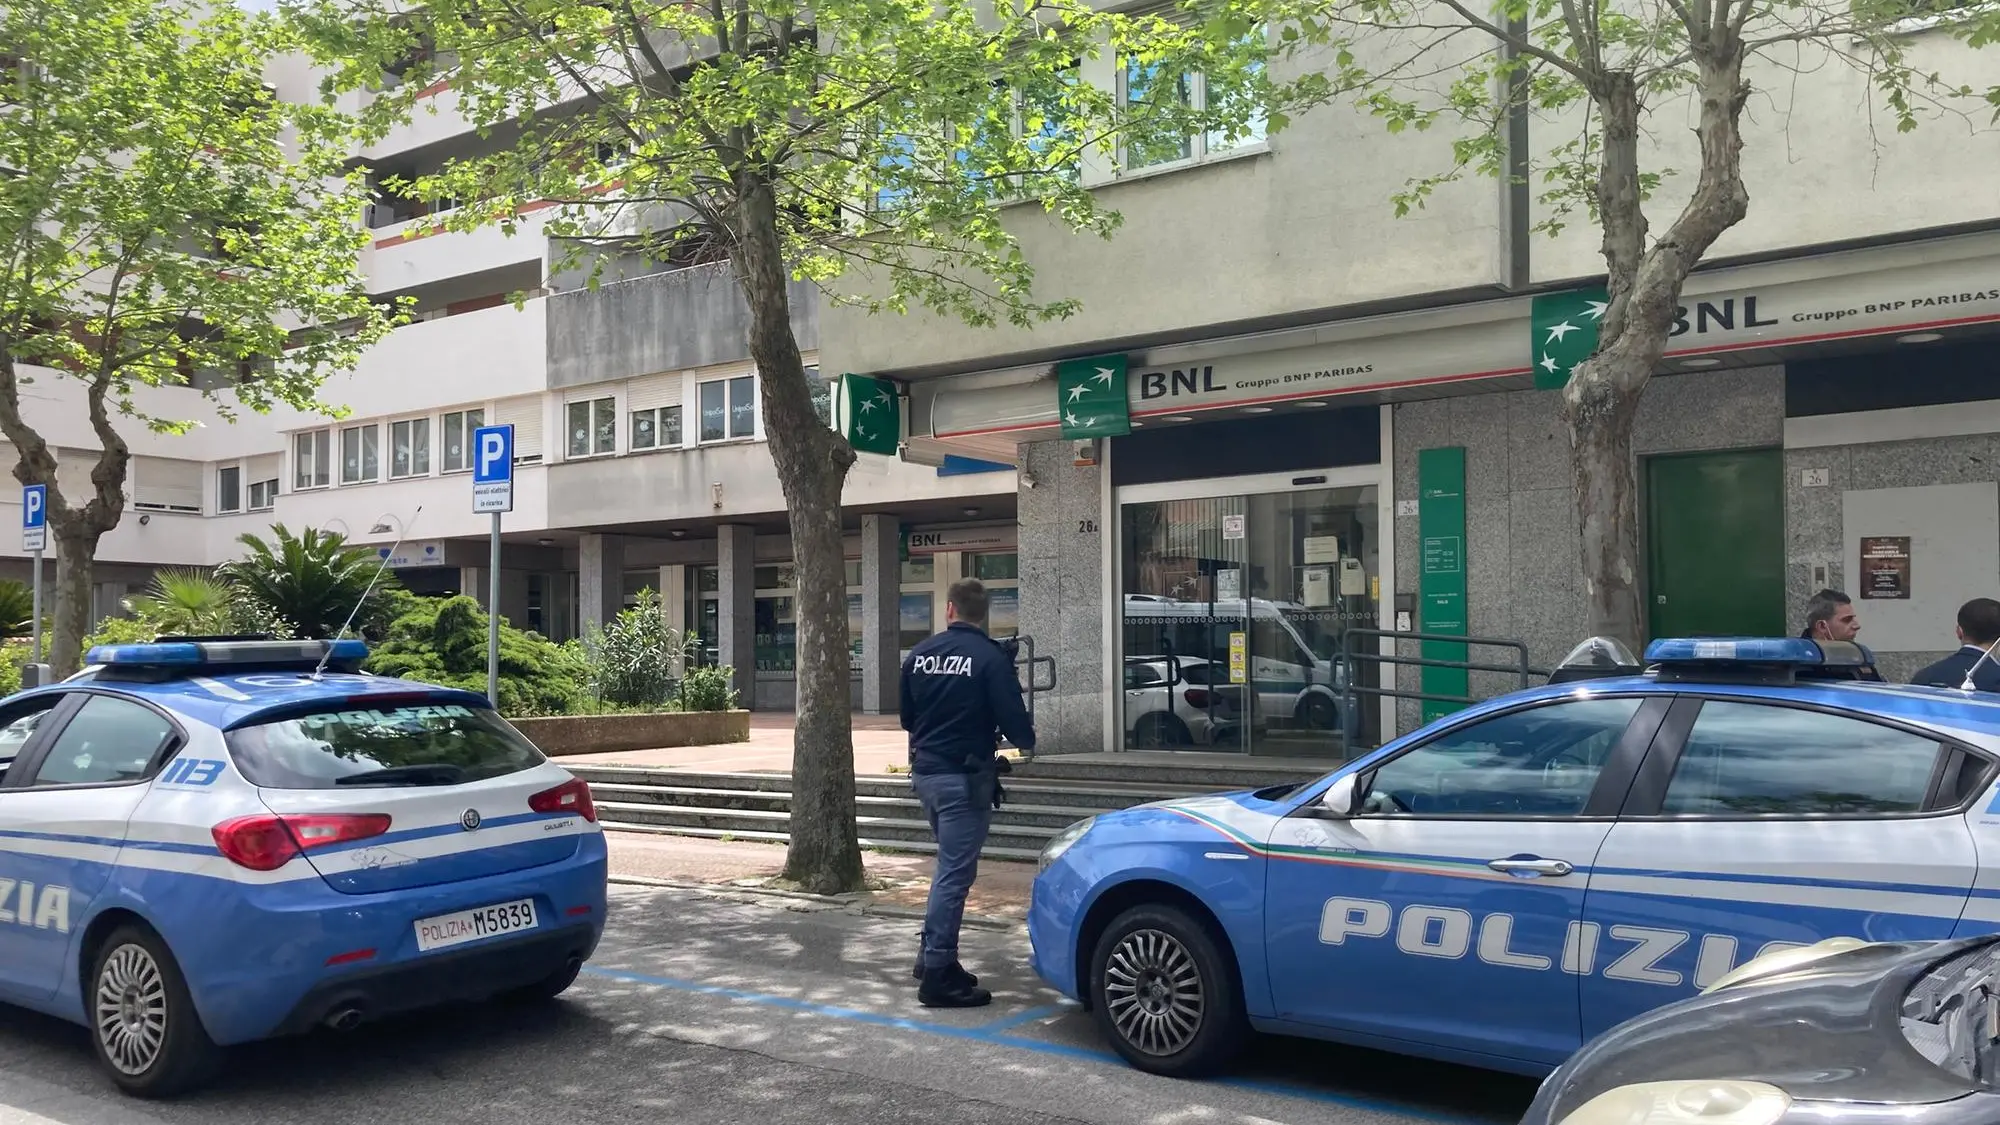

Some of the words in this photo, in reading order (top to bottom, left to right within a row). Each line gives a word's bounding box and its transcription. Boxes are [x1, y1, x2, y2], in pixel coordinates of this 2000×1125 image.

[1791, 307, 1858, 323] Gruppo
[1864, 300, 1906, 314] BNP
[1911, 288, 2000, 309] PARIBAS
[1140, 365, 1227, 401] BNL
[1235, 377, 1280, 389] Gruppo
[1284, 373, 1311, 383] BNP
[1314, 364, 1374, 379] PARIBAS
[482, 433, 504, 477] P
[27, 490, 41, 524] P
[911, 533, 947, 547] BNL
[912, 655, 973, 677] POLIZIA
[161, 757, 227, 786] 113
[422, 921, 468, 940] POLIZIA
[473, 903, 533, 935] M5839
[1318, 896, 1812, 990] POLIZI
